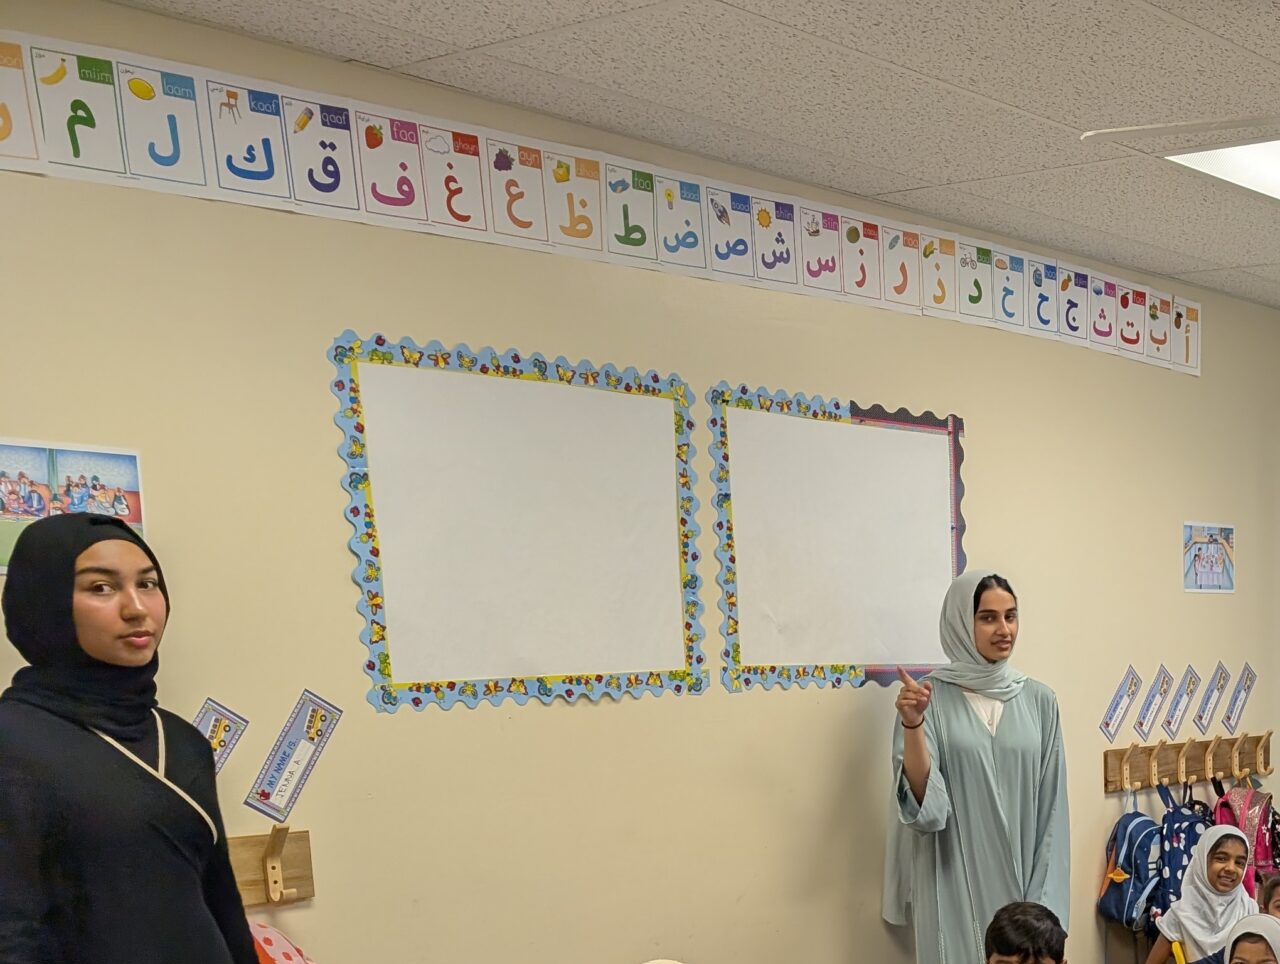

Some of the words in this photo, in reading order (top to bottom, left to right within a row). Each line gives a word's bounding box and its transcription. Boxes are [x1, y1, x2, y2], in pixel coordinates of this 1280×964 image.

[80, 66, 113, 83] miim
[163, 80, 193, 98] laam
[251, 102, 278, 114] kaaf
[321, 112, 348, 126] qaaf
[67, 99, 96, 158] م
[148, 114, 180, 166] ل
[393, 122, 416, 142] faa
[226, 138, 274, 180] ك
[308, 140, 341, 193] ق
[519, 150, 540, 167] ayn
[371, 162, 415, 207] ف
[444, 162, 471, 222] غ
[505, 179, 533, 228] ع
[559, 192, 593, 239] ظ
[614, 204, 646, 247] ط
[663, 219, 699, 253] ض
[715, 238, 749, 260] ص
[761, 232, 791, 270] ش
[806, 255, 836, 278] س
[855, 248, 867, 288] ز
[893, 262, 908, 295] ر
[933, 262, 946, 304] ذ
[968, 278, 982, 304] د
[1002, 275, 1015, 318] خ
[1037, 292, 1051, 326] ح
[1066, 298, 1079, 332] ج
[1092, 308, 1112, 338] ث
[1120, 320, 1140, 345] ت
[1150, 329, 1167, 352] ب
[1184, 323, 1190, 364] أ
[266, 774, 278, 789] MY
[273, 750, 291, 774] NAME
